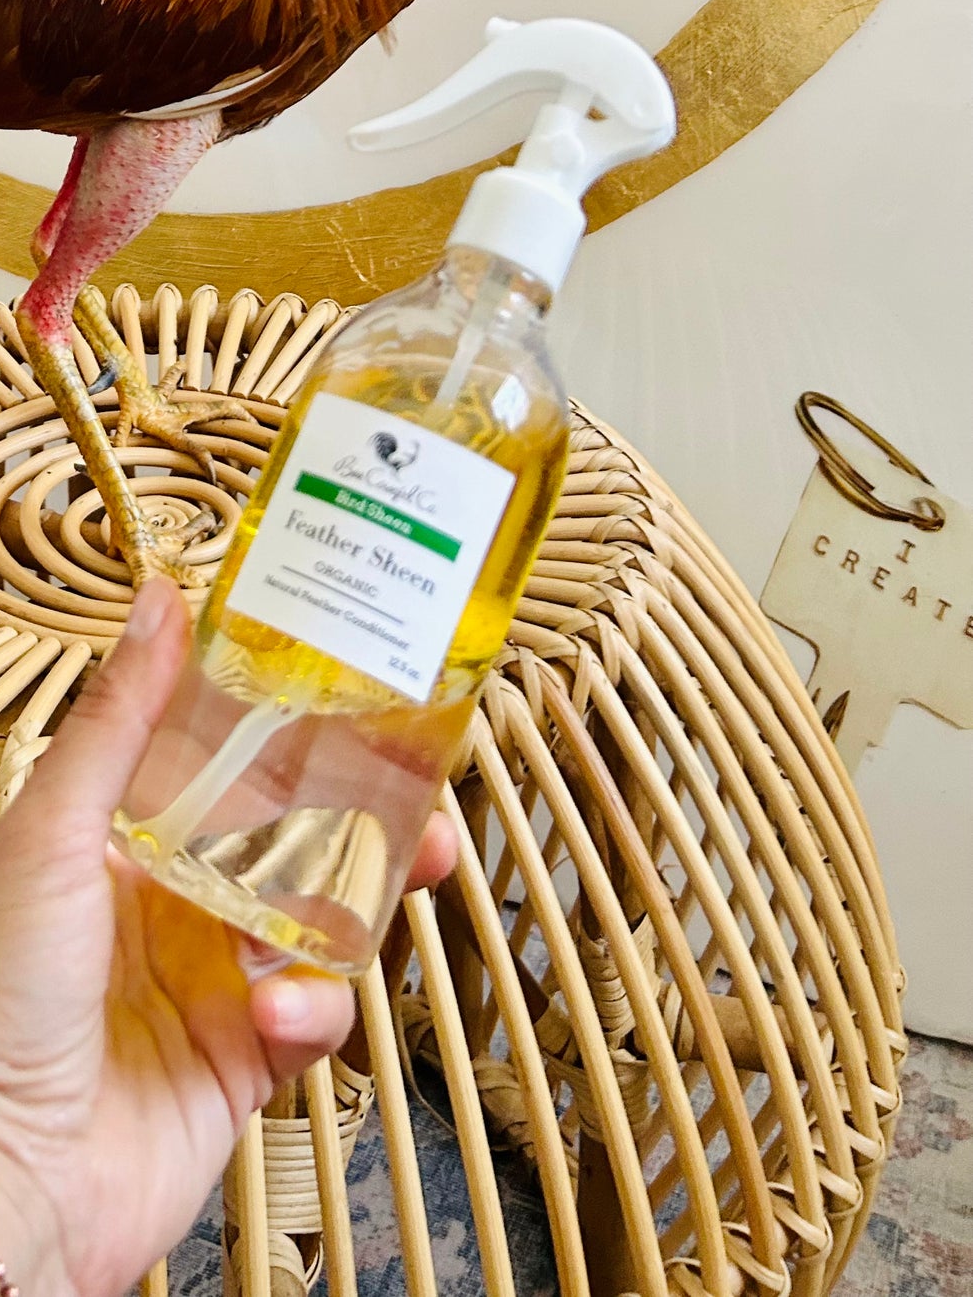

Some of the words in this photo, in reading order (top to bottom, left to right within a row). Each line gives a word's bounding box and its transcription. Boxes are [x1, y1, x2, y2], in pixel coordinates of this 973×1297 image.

[364, 501, 414, 535] Sheen
[284, 508, 364, 560] Feather
[366, 545, 439, 596] Sheen
[895, 539, 916, 564] I
[313, 559, 379, 598] ORGANIC
[263, 574, 300, 598] Natural
[300, 589, 342, 616] Feather
[342, 610, 411, 650] Conditioner
